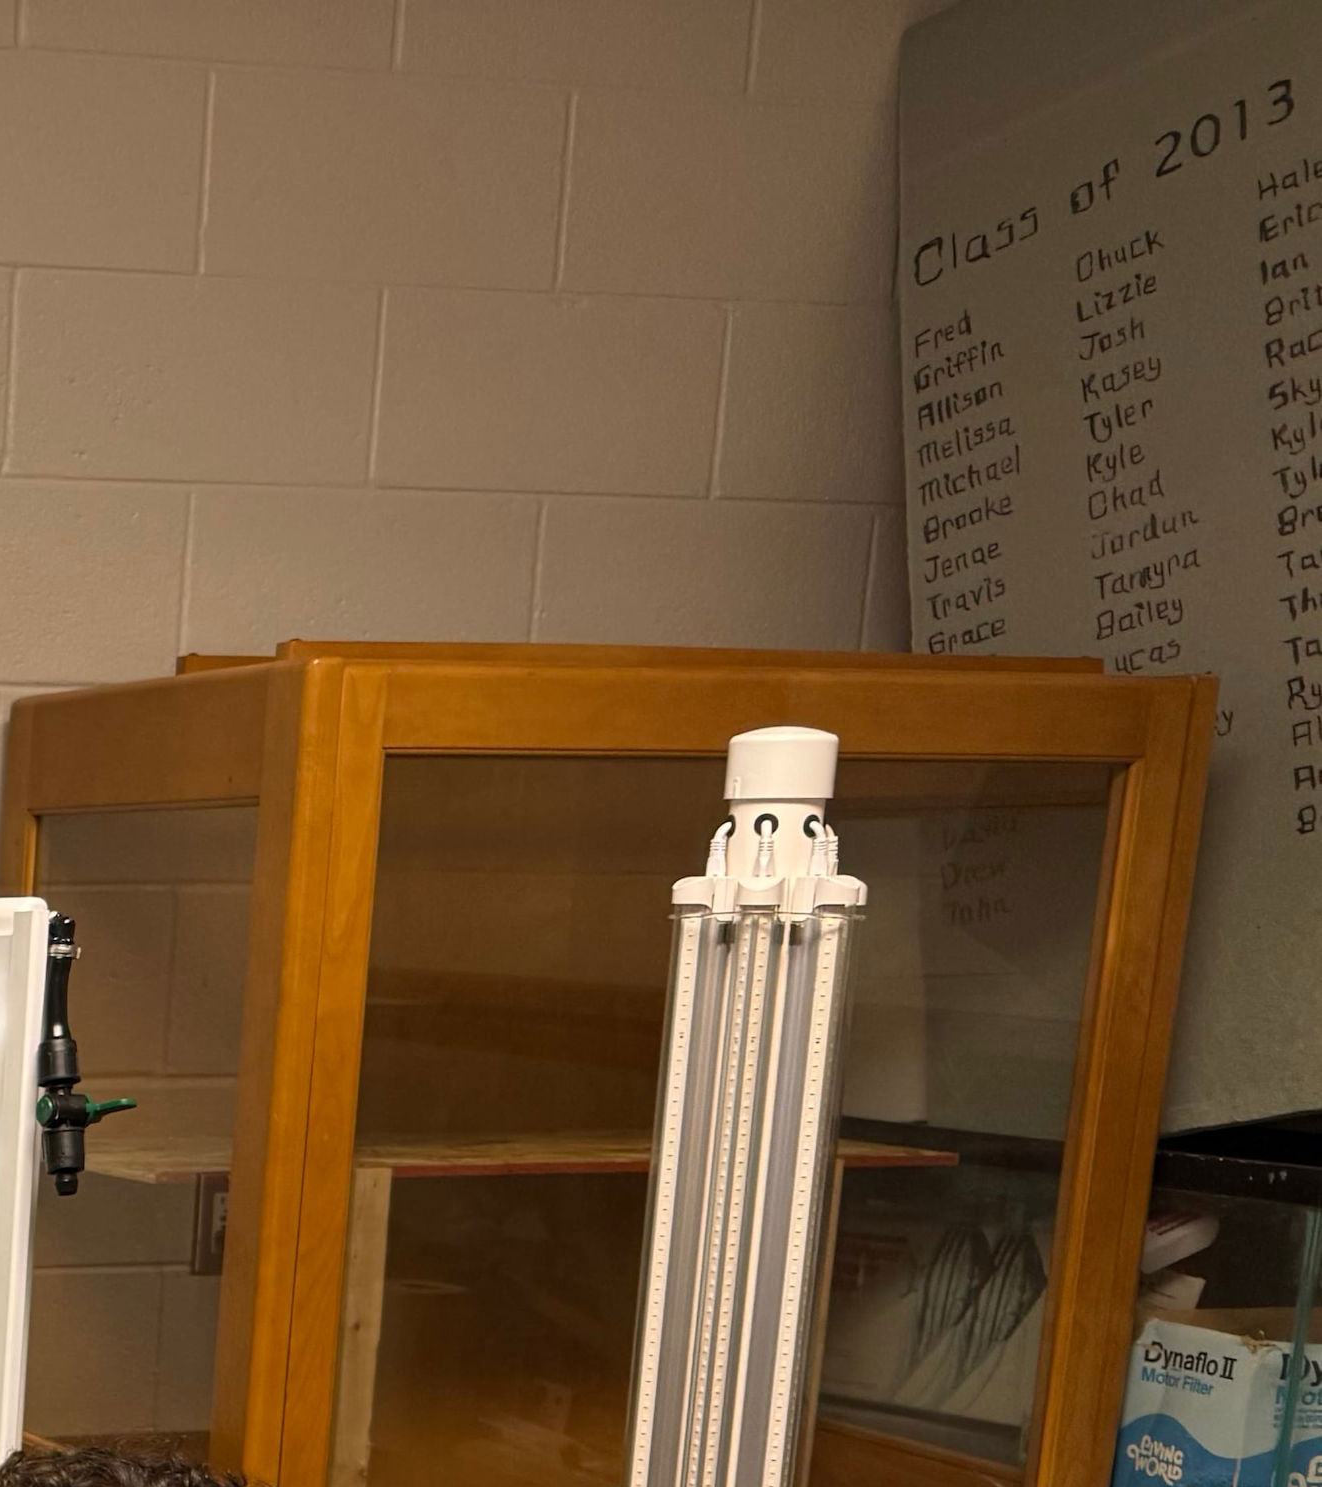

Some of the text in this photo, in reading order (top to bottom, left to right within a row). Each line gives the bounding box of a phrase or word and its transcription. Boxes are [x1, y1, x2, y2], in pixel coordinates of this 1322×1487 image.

[913, 78, 1295, 286] Class of 2013
[1260, 252, 1309, 285] Ian
[1076, 273, 1157, 323] Lizzie
[914, 308, 972, 359] Fred
[1079, 316, 1145, 361] Josh
[913, 340, 1005, 394] Griffin
[1081, 356, 1161, 403] Kasey
[918, 381, 1004, 432] Allison
[1083, 398, 1154, 443] Tyler
[917, 417, 1016, 468] Melissa
[1271, 411, 1322, 455] Kyl
[917, 443, 1020, 506] Michael
[1087, 442, 1145, 483] Kyle
[1272, 455, 1322, 499] Tyl
[1088, 466, 1165, 520] Chad
[923, 496, 1013, 545] Brooke
[924, 542, 1002, 583] Jenae
[926, 577, 1006, 620] Travis
[1096, 598, 1184, 640] Bailey
[928, 618, 1006, 655] Grace
[1115, 639, 1181, 674] ucas
[1141, 1366, 1214, 1396] Motor Filter
[1144, 1341, 1219, 1376] Dynaflo
